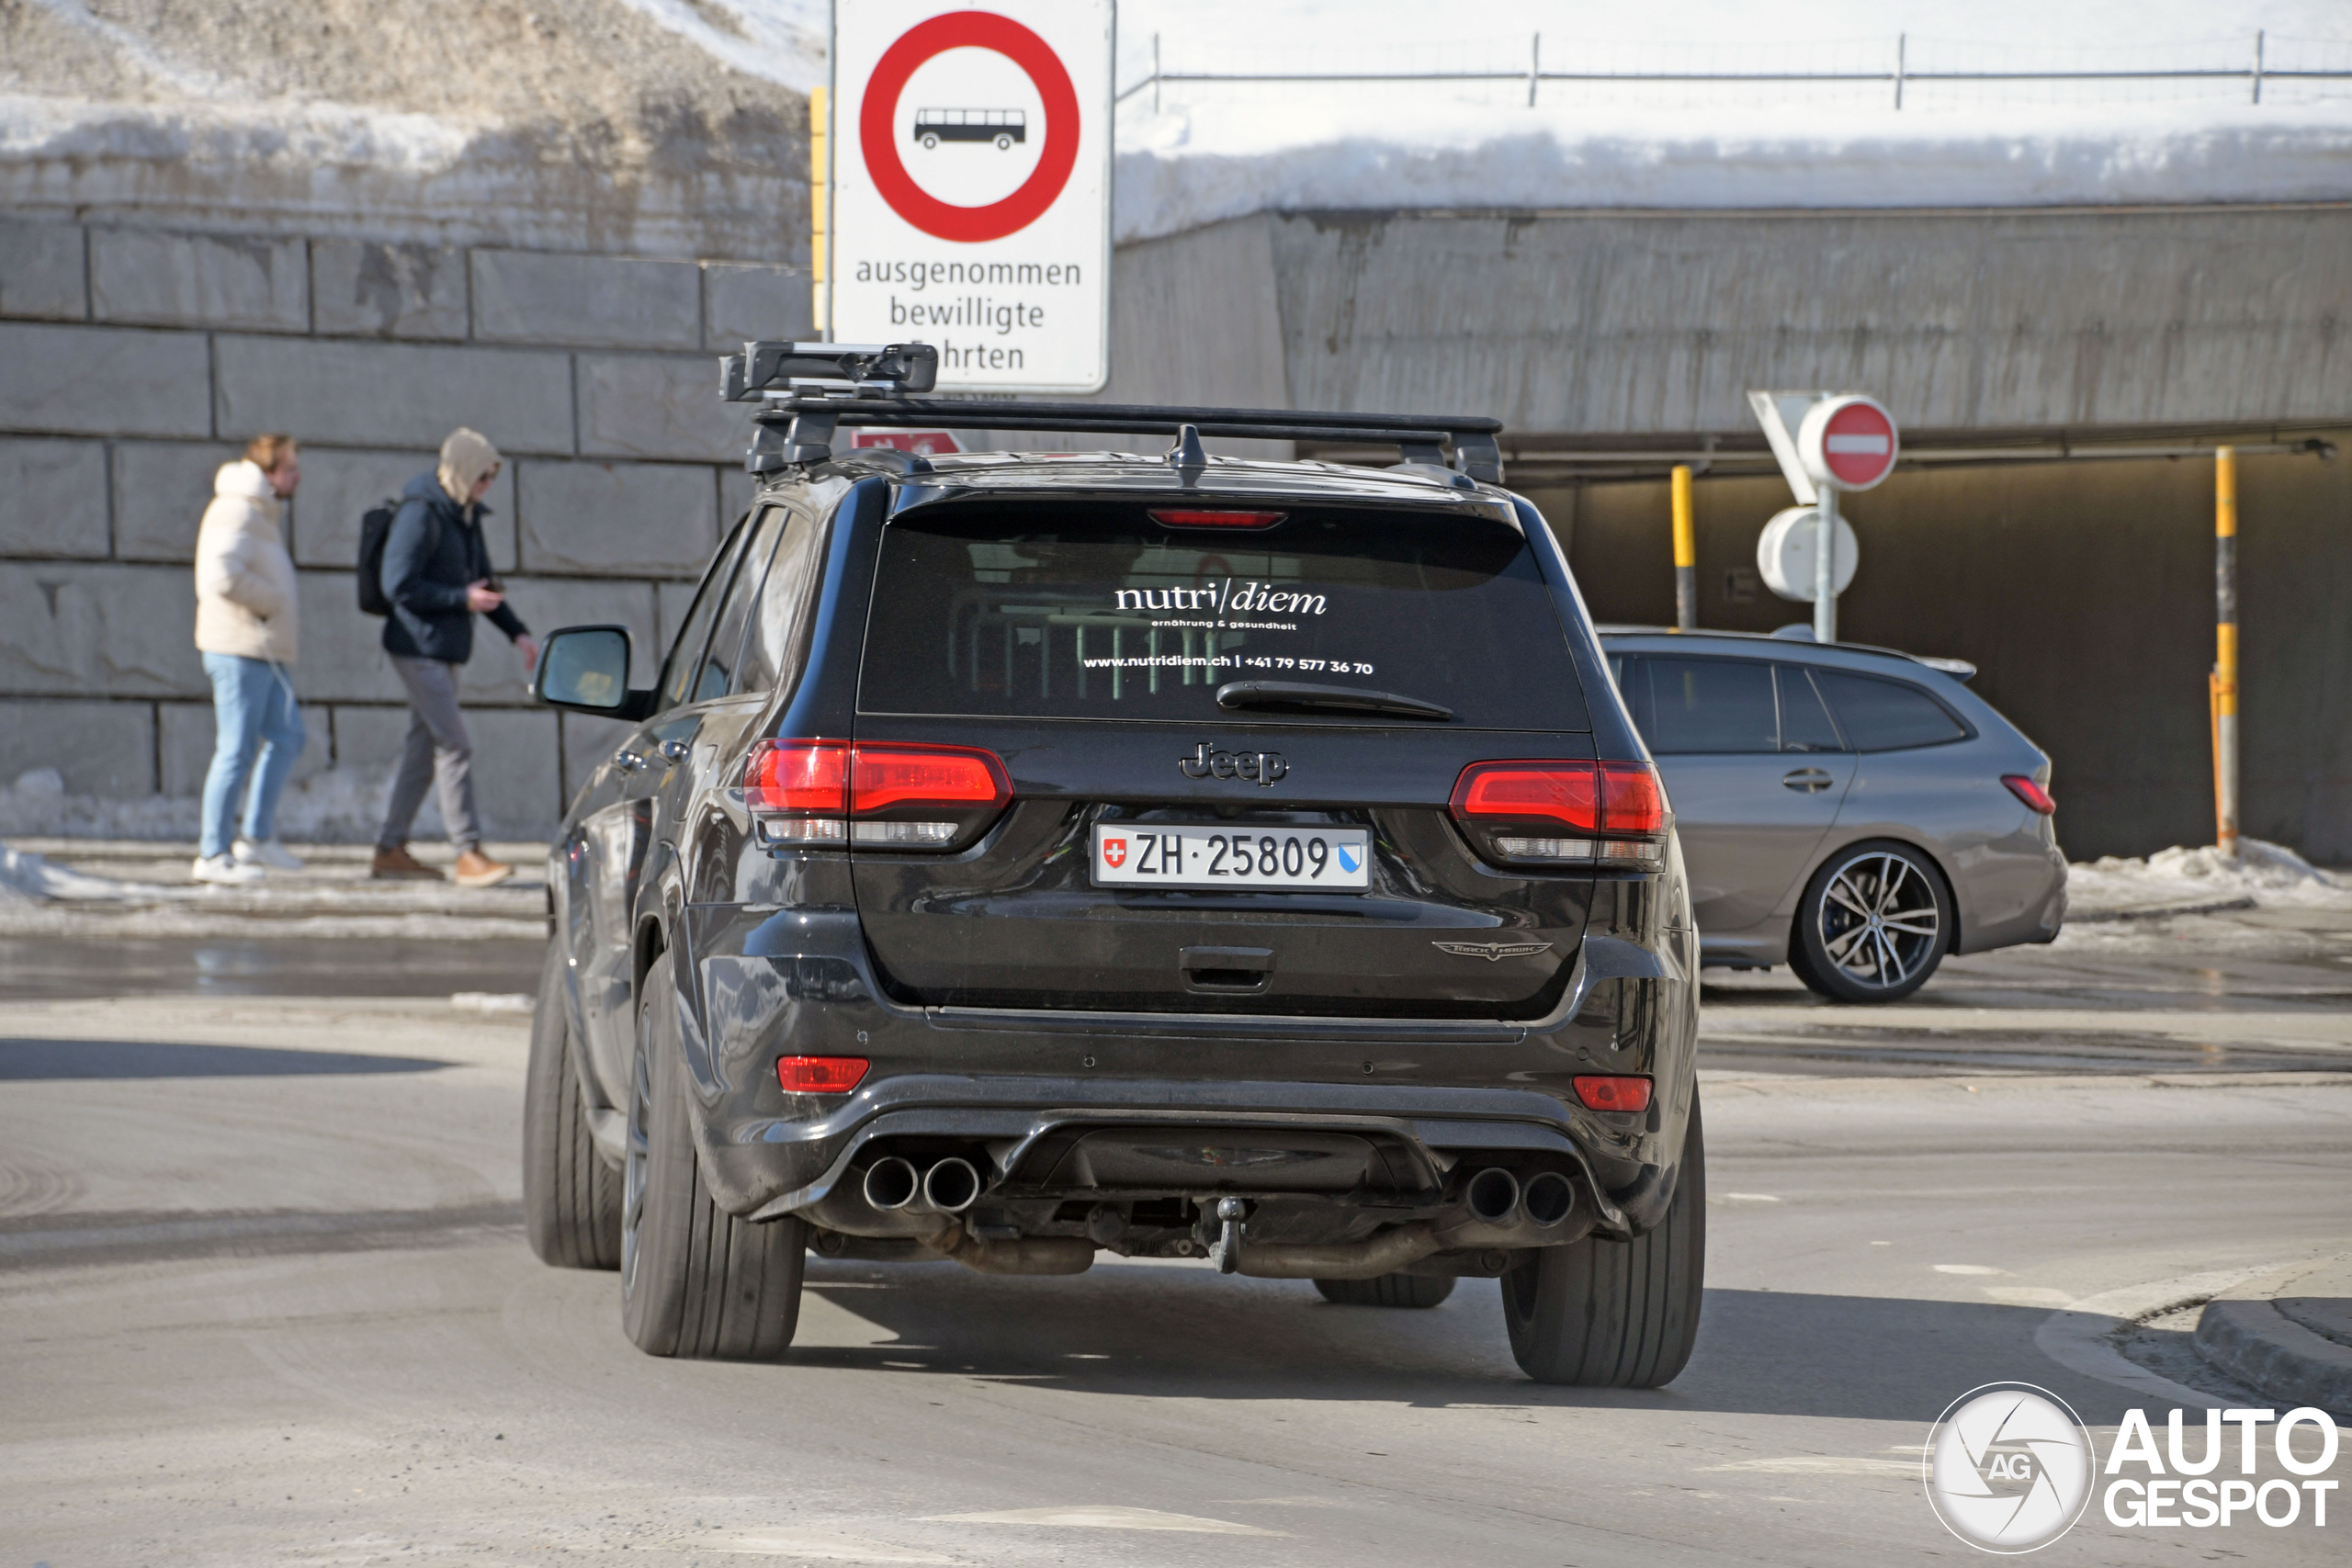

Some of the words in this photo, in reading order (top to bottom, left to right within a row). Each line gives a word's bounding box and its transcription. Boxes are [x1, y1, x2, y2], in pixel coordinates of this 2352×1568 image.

[855, 260, 1081, 291] ausgenommen
[889, 296, 1045, 334] bewilligte
[911, 339, 1024, 369] hrten
[1151, 618, 1214, 629] ernährung
[1217, 619, 1226, 627] &
[1229, 620, 1297, 631] gesundheit
[1083, 655, 1231, 669] www.nutridiem.ch
[1244, 656, 1272, 669] +41
[1274, 657, 1295, 670] 79
[1298, 659, 1326, 671] 577
[1329, 660, 1351, 673] 36
[1353, 662, 1374, 675] 70
[1179, 742, 1288, 787] Jeep
